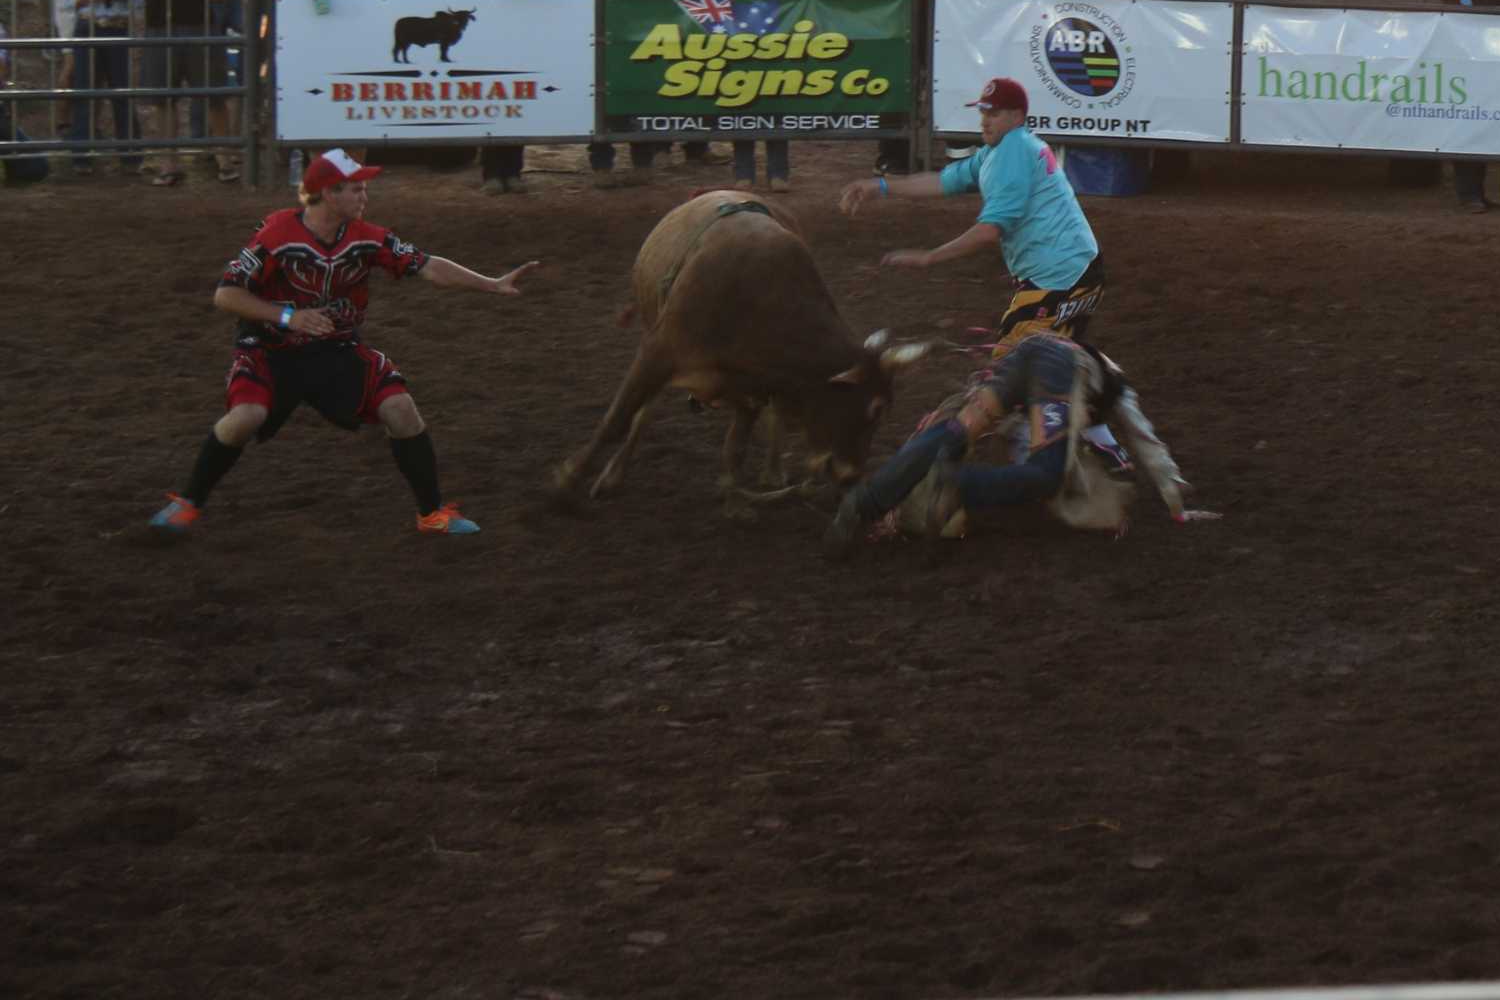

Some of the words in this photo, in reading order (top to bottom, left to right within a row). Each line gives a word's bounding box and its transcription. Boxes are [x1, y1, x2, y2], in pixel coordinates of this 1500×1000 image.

[1054, 2, 1127, 42] CONSTRUCTION
[629, 20, 850, 61] Aussie
[1049, 30, 1106, 54] ABR
[331, 81, 538, 102] BERRIMAH
[657, 58, 838, 108] Signs
[840, 69, 890, 97] Co
[1099, 57, 1136, 110] ELECTRICAL
[1257, 56, 1468, 106] handrails
[344, 104, 523, 121] LIVESTOCK
[637, 116, 711, 132] TOTAL
[718, 115, 775, 131] SIGN
[781, 115, 880, 131] SERVICE
[1026, 116, 1051, 129] BR
[1056, 117, 1121, 133] GROUP
[1125, 120, 1150, 133] NT
